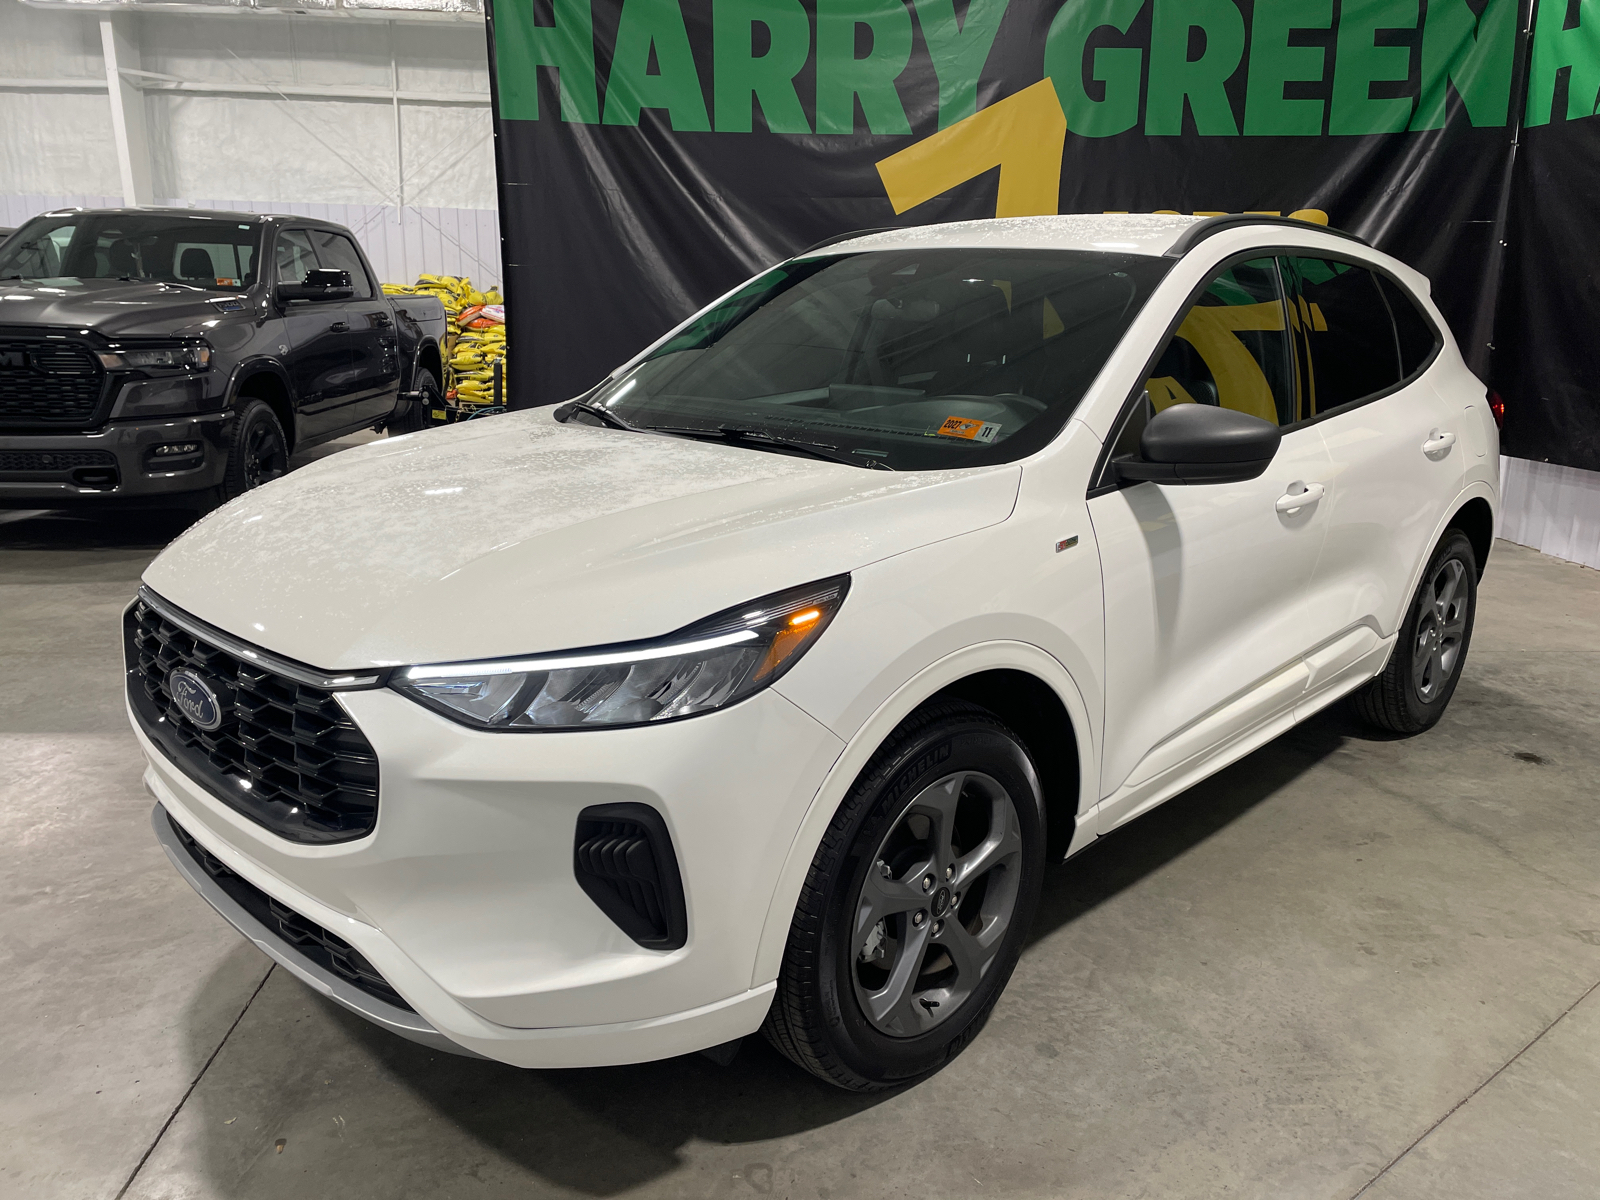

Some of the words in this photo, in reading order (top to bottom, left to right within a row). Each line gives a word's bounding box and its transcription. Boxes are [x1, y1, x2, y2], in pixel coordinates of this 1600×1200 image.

[499, 0, 1007, 135] HARRY
[1043, 0, 1519, 137] GREEN
[943, 419, 963, 430] 2027
[981, 426, 993, 438] 11
[176, 681, 204, 718] Ford
[881, 744, 950, 814] MICHELIN
